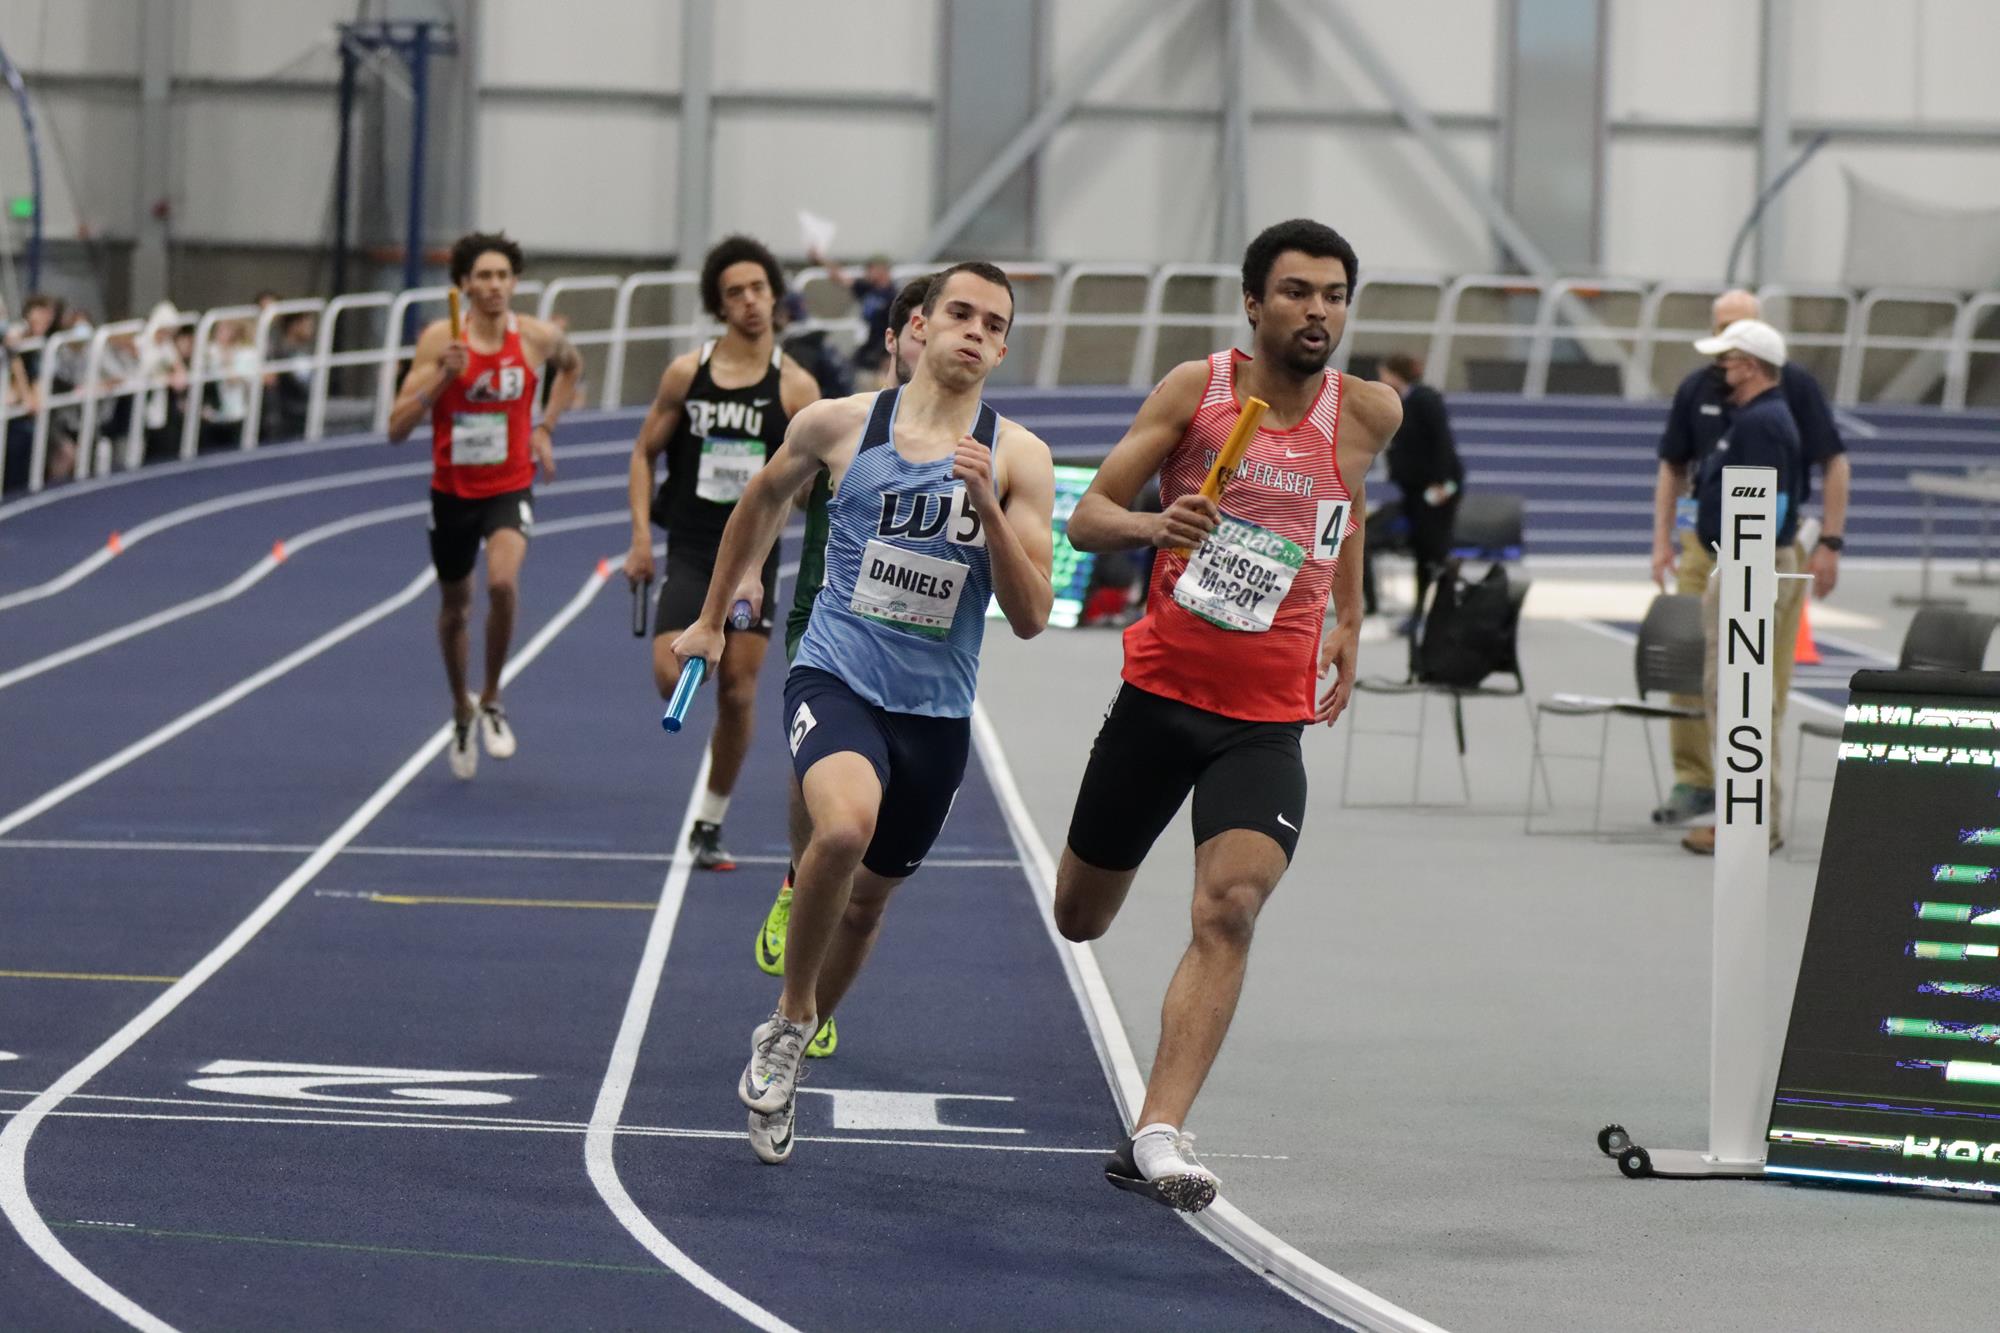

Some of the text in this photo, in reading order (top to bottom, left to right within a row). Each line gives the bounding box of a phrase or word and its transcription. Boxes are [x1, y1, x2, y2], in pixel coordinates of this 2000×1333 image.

[1204, 448, 1250, 480] SIN
[1252, 462, 1314, 498] FRASER
[1731, 486, 1766, 498] GILL
[956, 490, 981, 543] 5
[1321, 505, 1344, 556] 4
[869, 558, 954, 600] DANIELS
[1198, 540, 1282, 594] PENSON-
[1726, 513, 1766, 825] FINISH
[792, 711, 808, 747] 5
